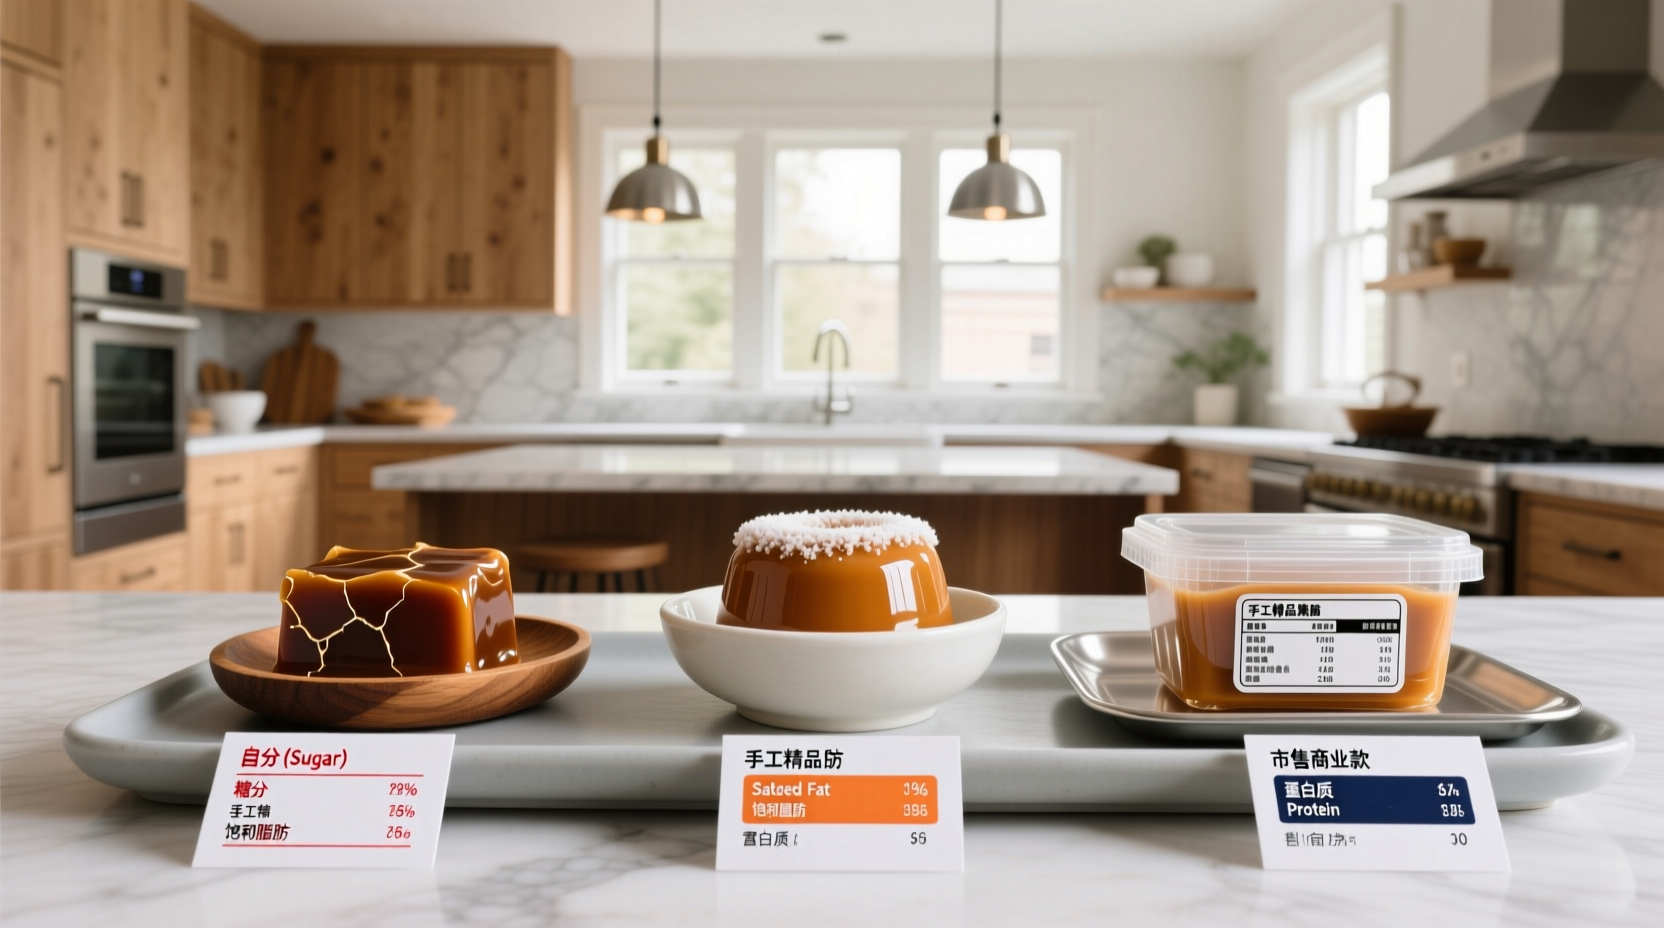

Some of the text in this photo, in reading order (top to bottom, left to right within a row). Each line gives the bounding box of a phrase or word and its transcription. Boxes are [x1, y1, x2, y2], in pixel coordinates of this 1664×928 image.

[241, 746, 348, 771] 自分 (Sugar)
[808, 782, 831, 797] Fat
[1287, 802, 1340, 818] Protein
